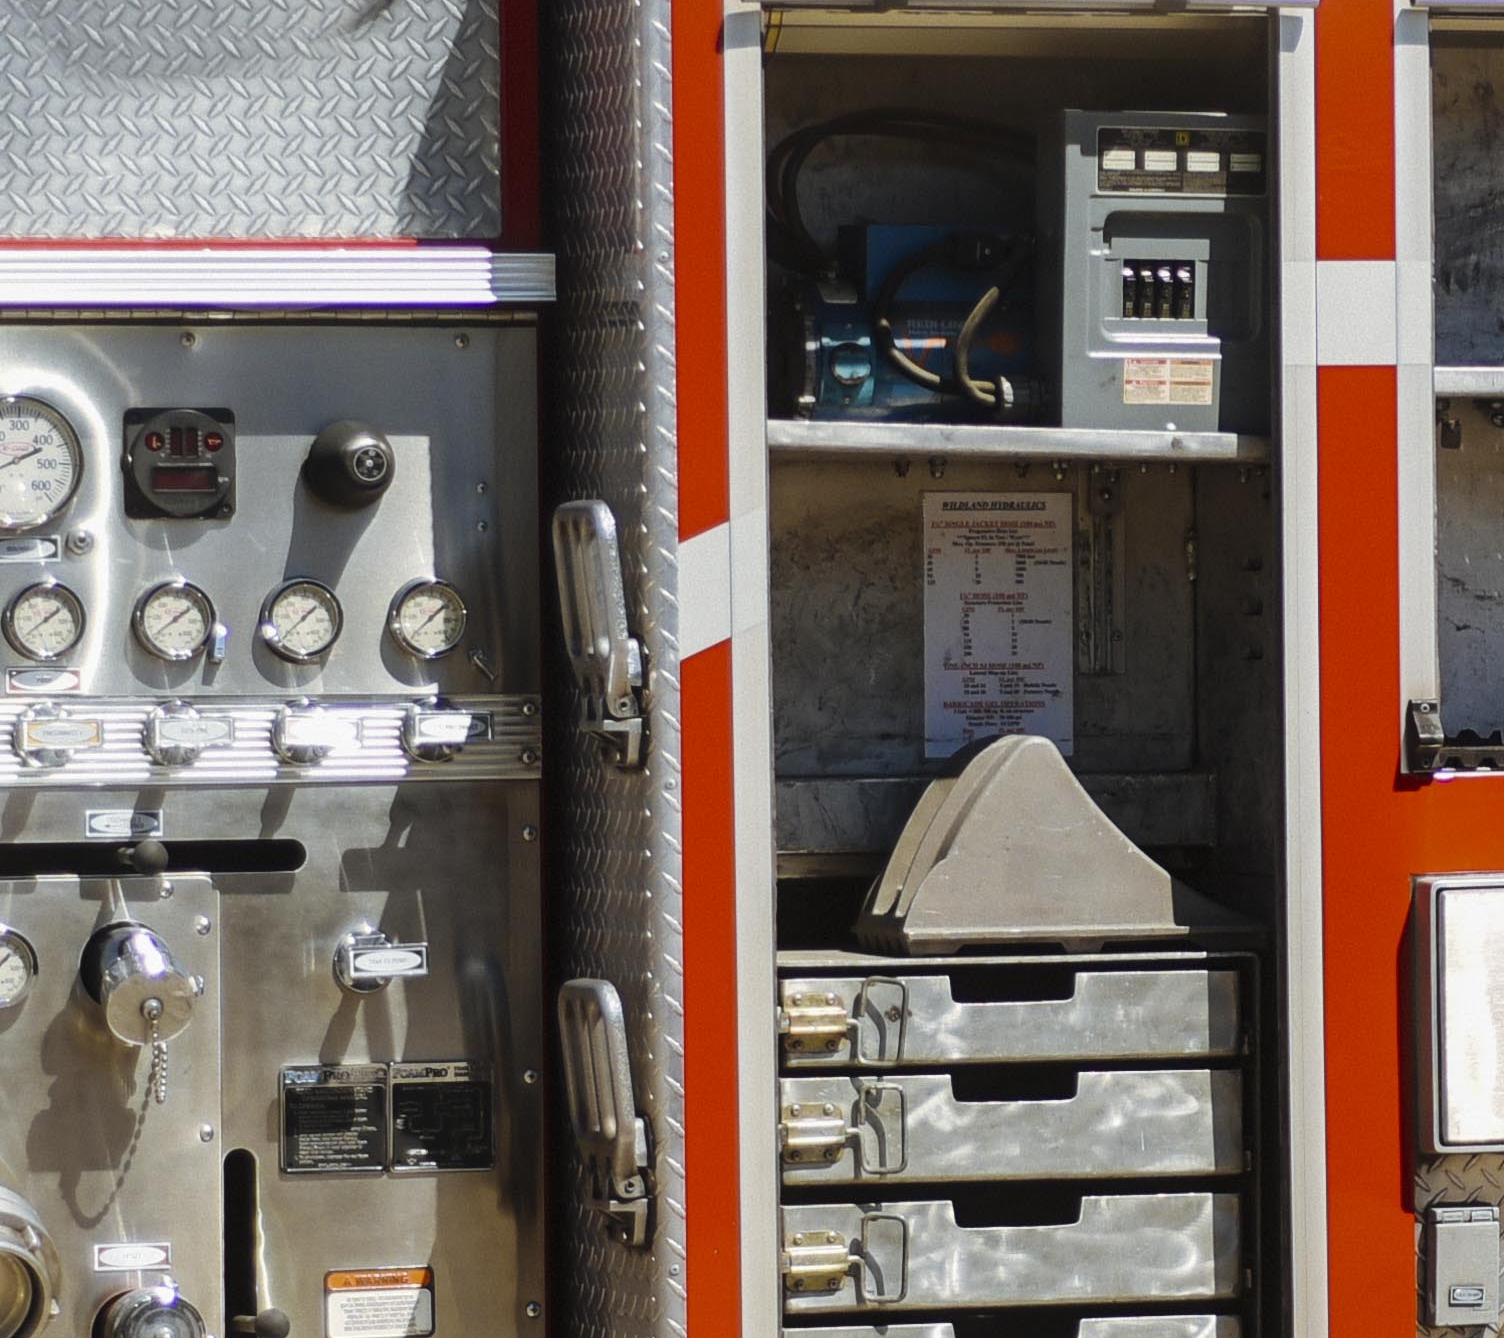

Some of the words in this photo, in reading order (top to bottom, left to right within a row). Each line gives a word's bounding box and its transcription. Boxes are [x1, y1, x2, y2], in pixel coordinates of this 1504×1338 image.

[9, 420, 29, 430] 300
[32, 434, 53, 445] 400
[37, 459, 57, 469] 500
[31, 480, 51, 491] 600
[942, 501, 989, 510] WILDLAND
[990, 501, 1047, 510] HYDRAULICS
[356, 1272, 408, 1284] WARNING
